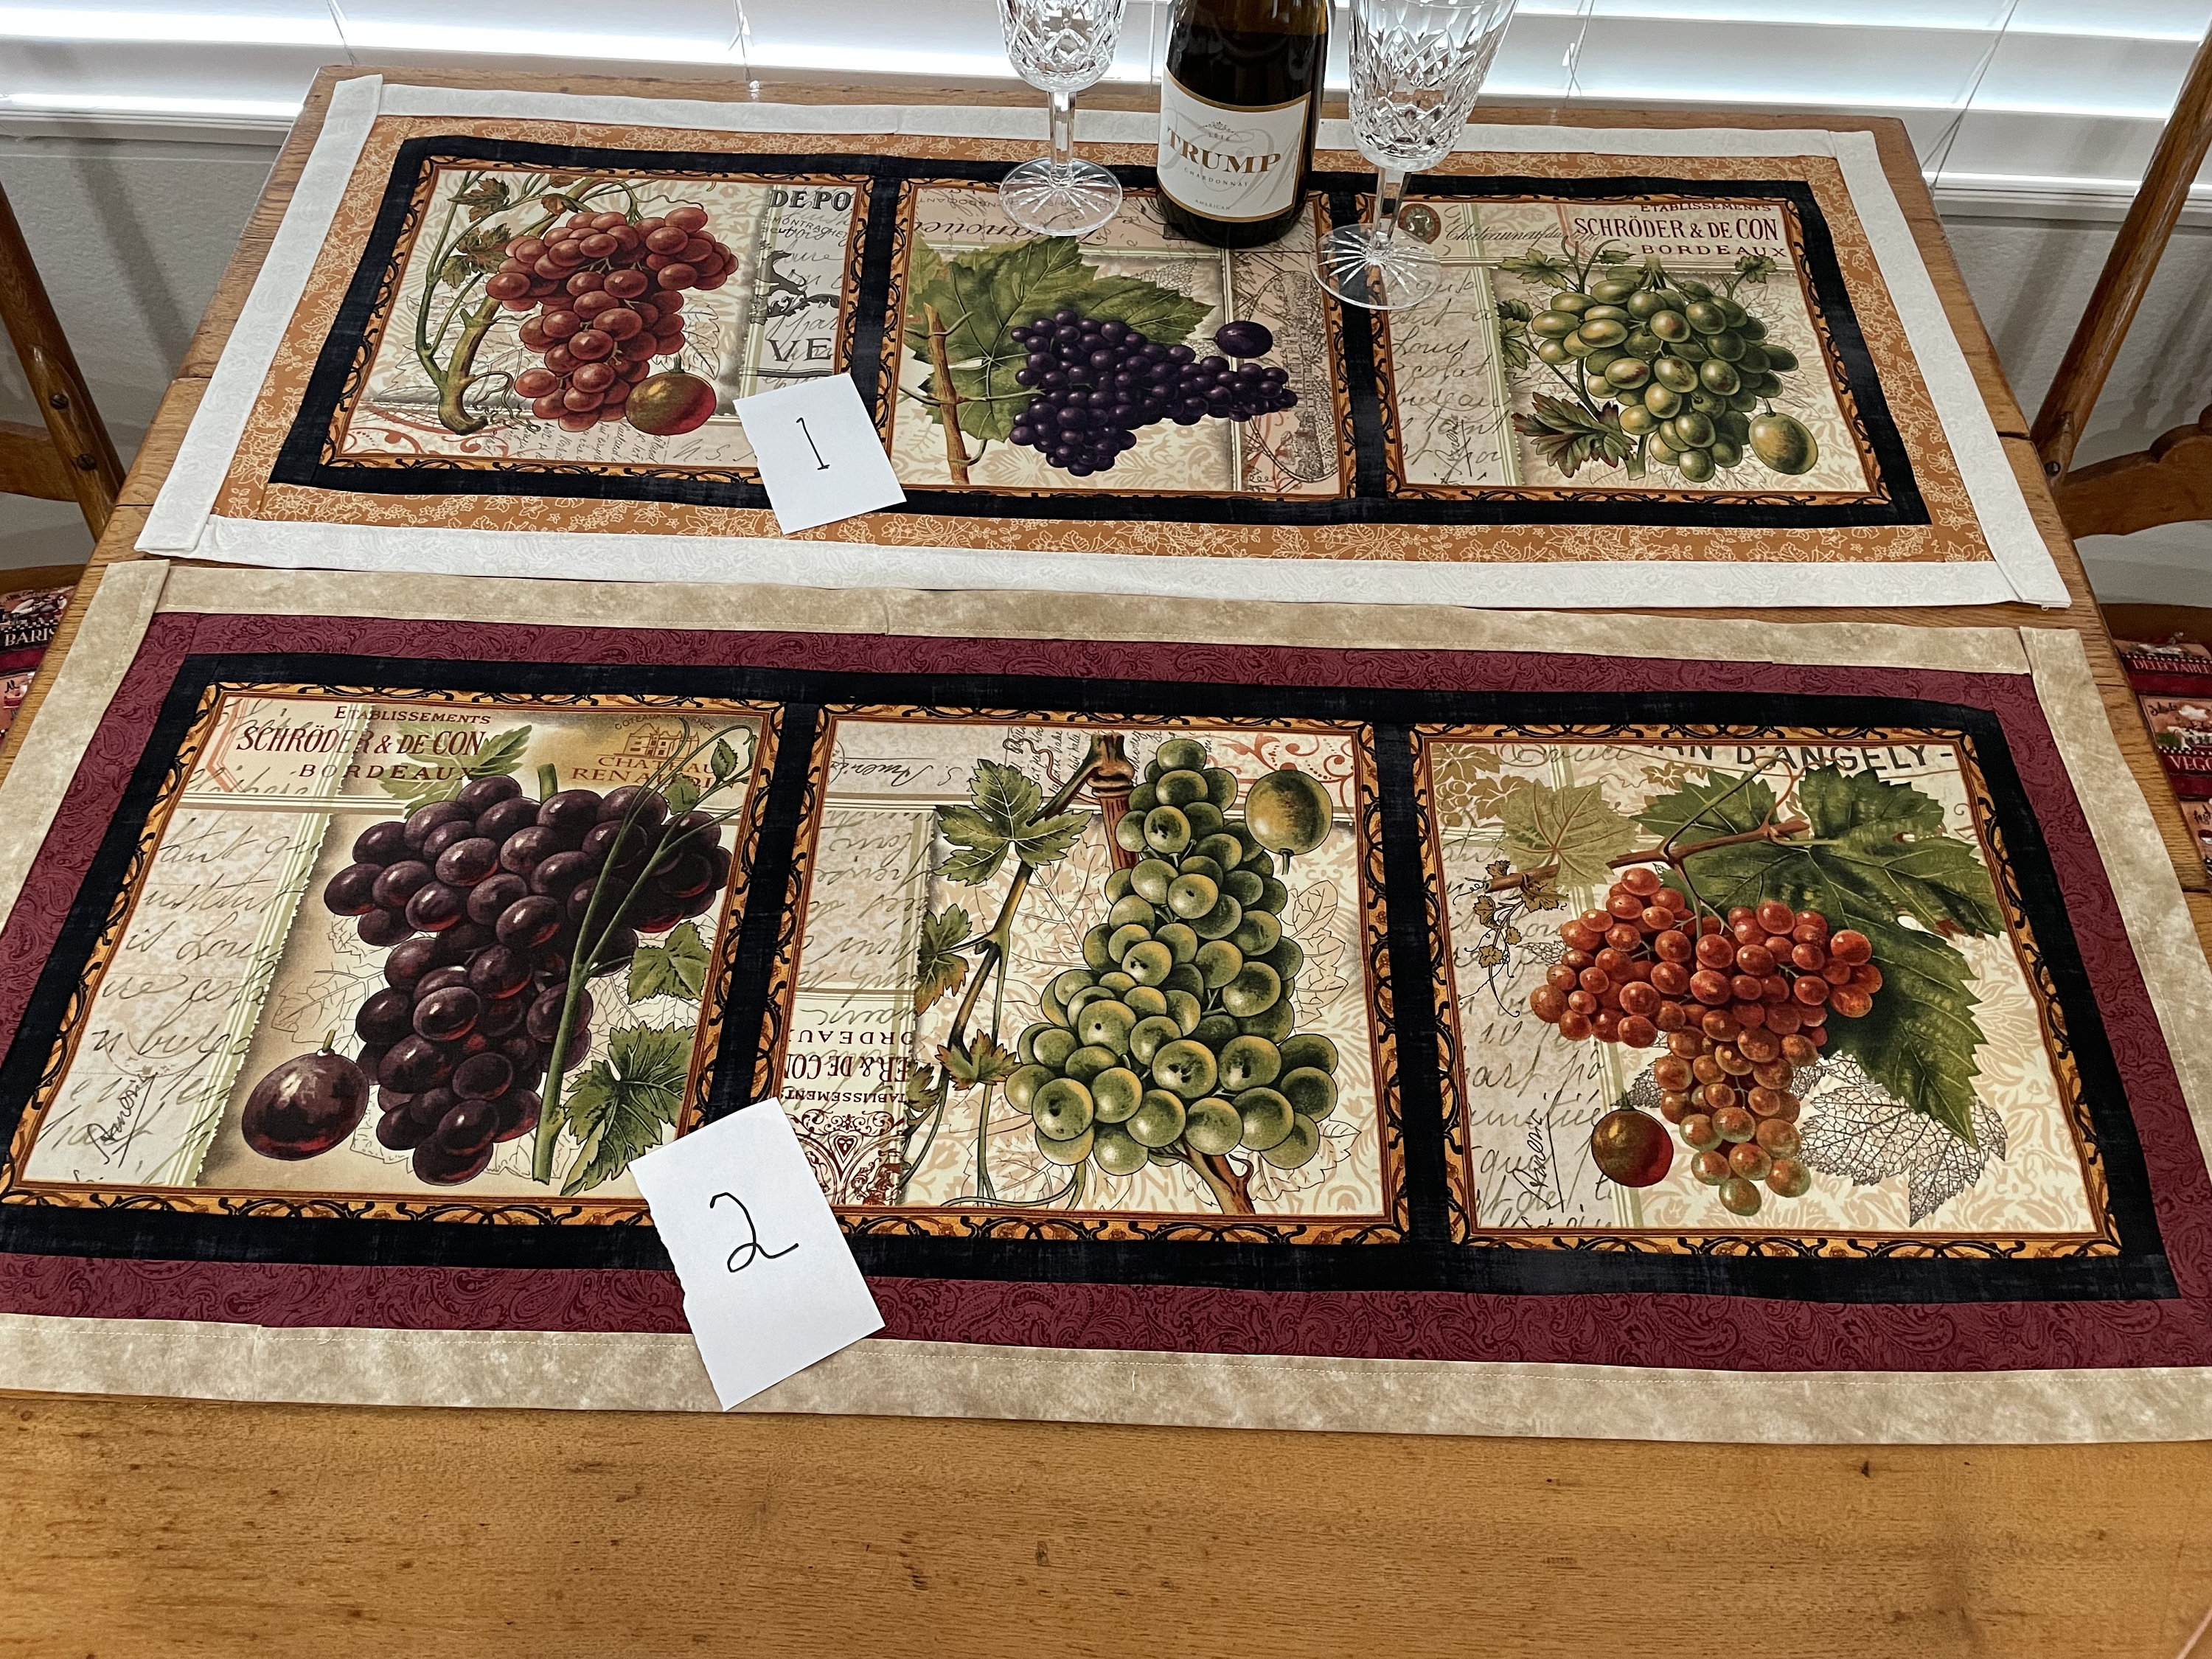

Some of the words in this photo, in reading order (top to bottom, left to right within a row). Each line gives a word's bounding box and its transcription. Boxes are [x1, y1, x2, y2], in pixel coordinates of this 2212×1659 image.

[1168, 126, 1281, 174] TRUMP
[1183, 167, 1248, 187] CHARDONNAY
[768, 189, 807, 209] DE
[1194, 198, 1231, 211] AMERICAN
[1574, 215, 1687, 239] SCHRÖDER
[1690, 223, 1703, 239] &
[1707, 222, 1732, 238] DE
[1736, 218, 1779, 241] CON
[1641, 245, 1787, 257] BORDEAUX
[796, 417, 830, 470] 1
[334, 706, 491, 724] ETABLISSEMENTS
[236, 726, 375, 754] SCHRÖDER
[375, 736, 392, 754] &
[396, 734, 426, 754] DE
[432, 731, 486, 756] CON
[299, 764, 476, 780] BORDEAUX
[709, 1192, 799, 1273] 2
